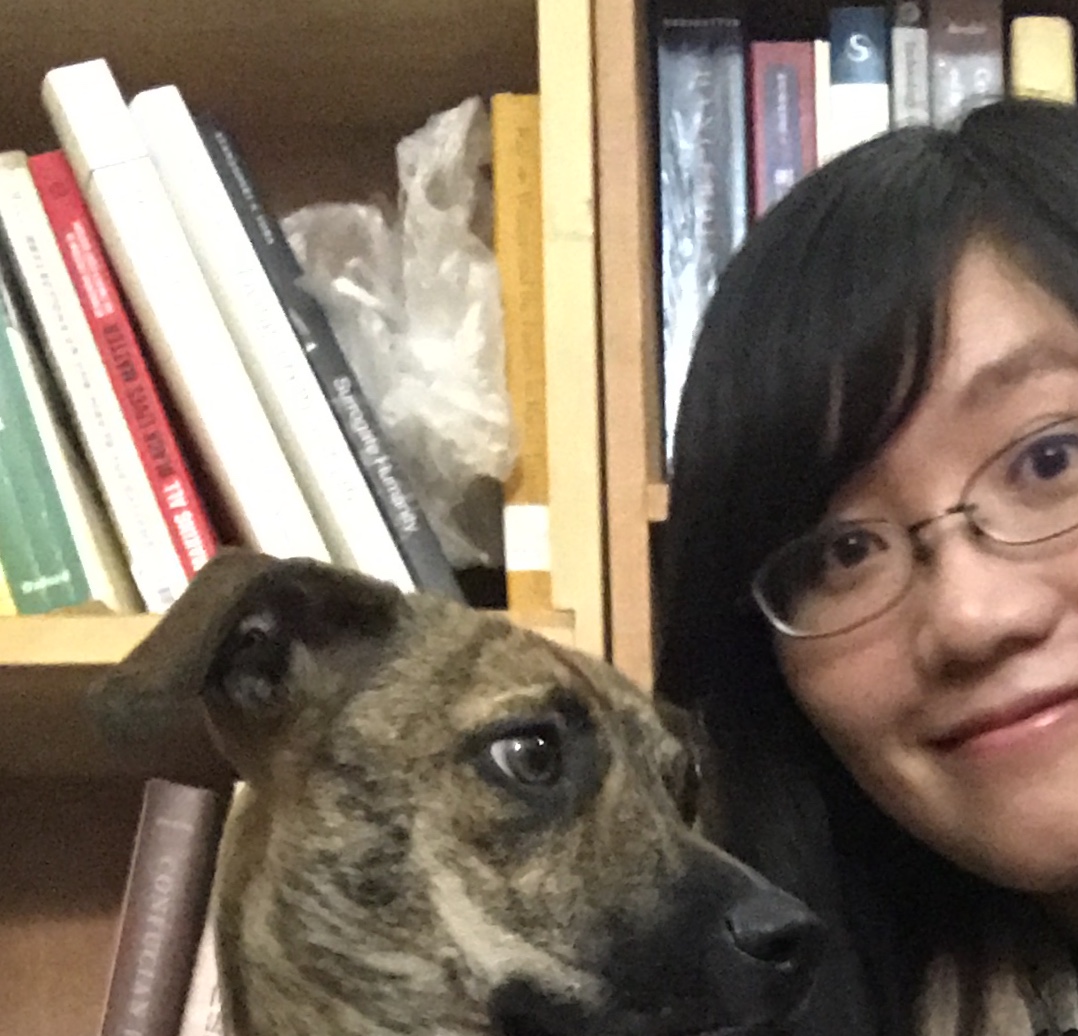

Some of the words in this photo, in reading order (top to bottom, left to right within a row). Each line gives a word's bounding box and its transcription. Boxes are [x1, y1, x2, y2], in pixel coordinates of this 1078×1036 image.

[101, 324, 137, 385] MATTER
[160, 481, 185, 512] ALL
[333, 376, 382, 458] Surrogate
[372, 454, 419, 534] Humanity
[135, 857, 174, 1017] CONFUCIAN
